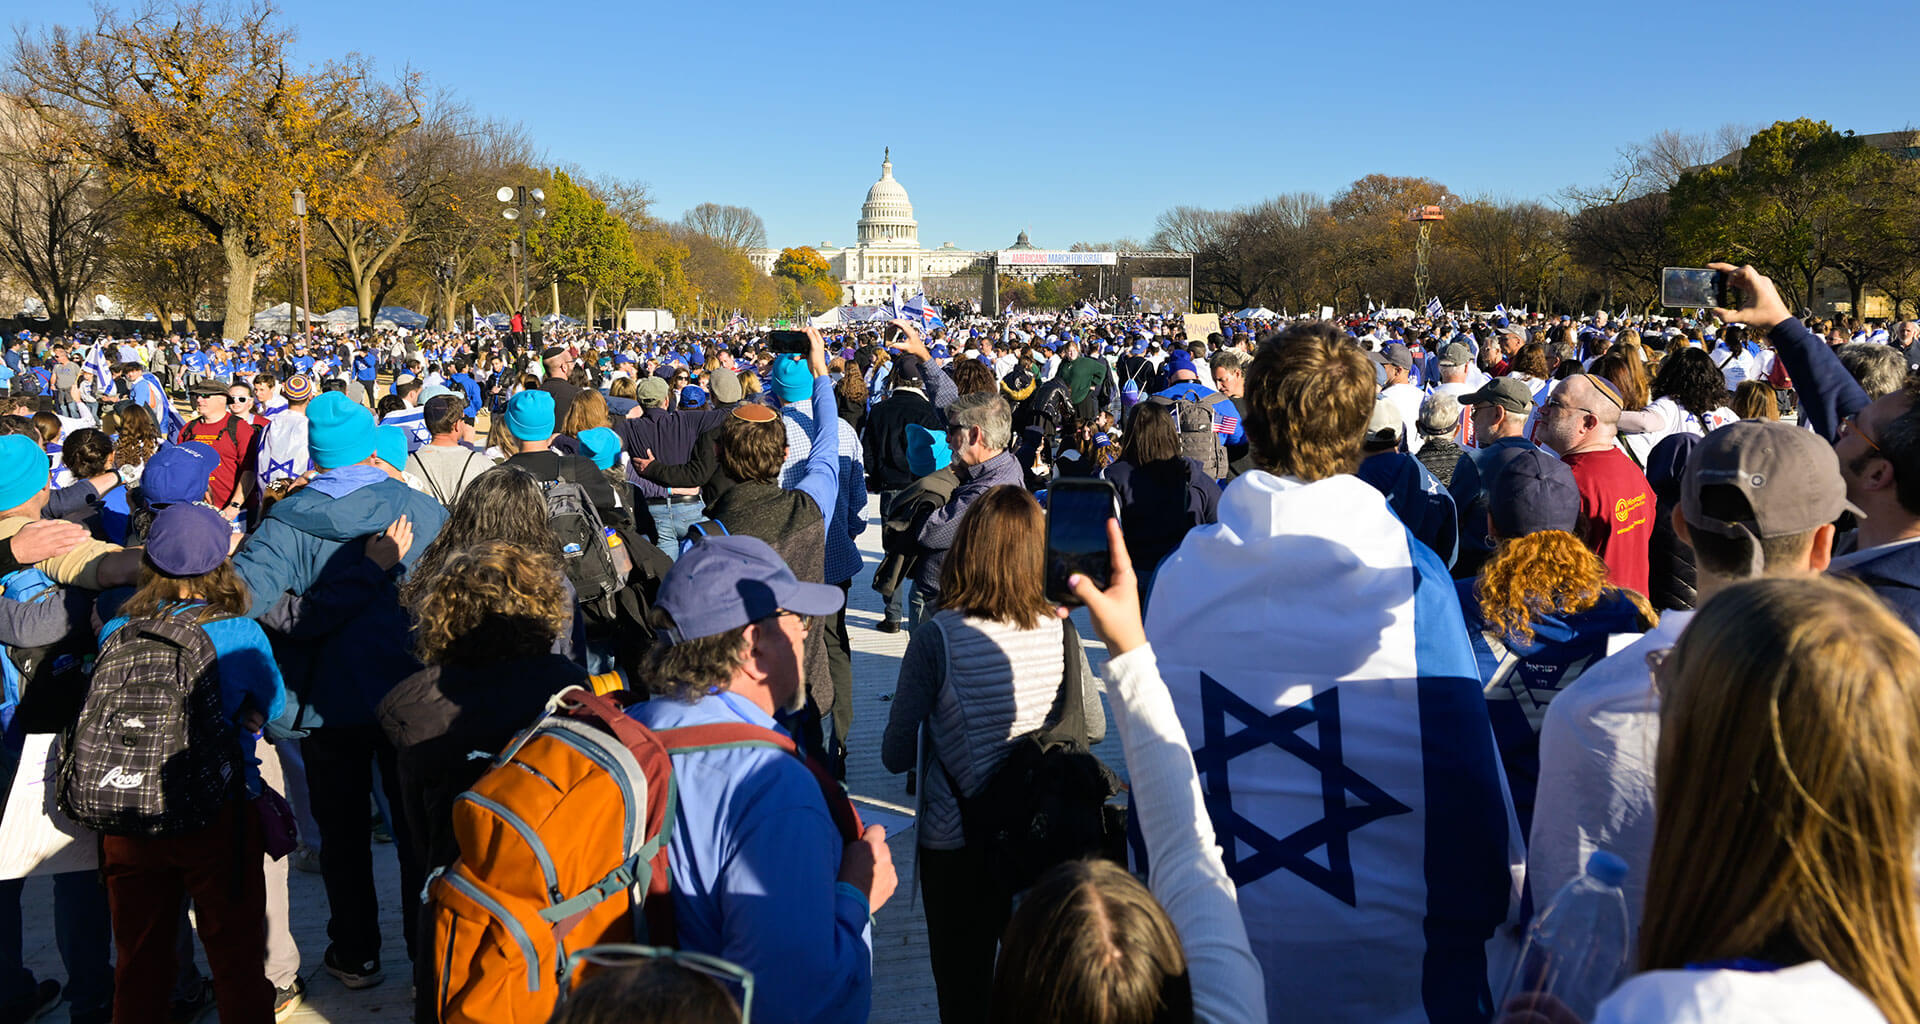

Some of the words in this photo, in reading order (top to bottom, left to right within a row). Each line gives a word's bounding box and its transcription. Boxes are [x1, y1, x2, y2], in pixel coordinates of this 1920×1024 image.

[1011, 253, 1048, 264] AMERICANS
[1048, 253, 1070, 264] MARCH
[1071, 253, 1083, 264] FOR
[1083, 253, 1103, 264] ISRAEL
[99, 766, 145, 788] Roots
